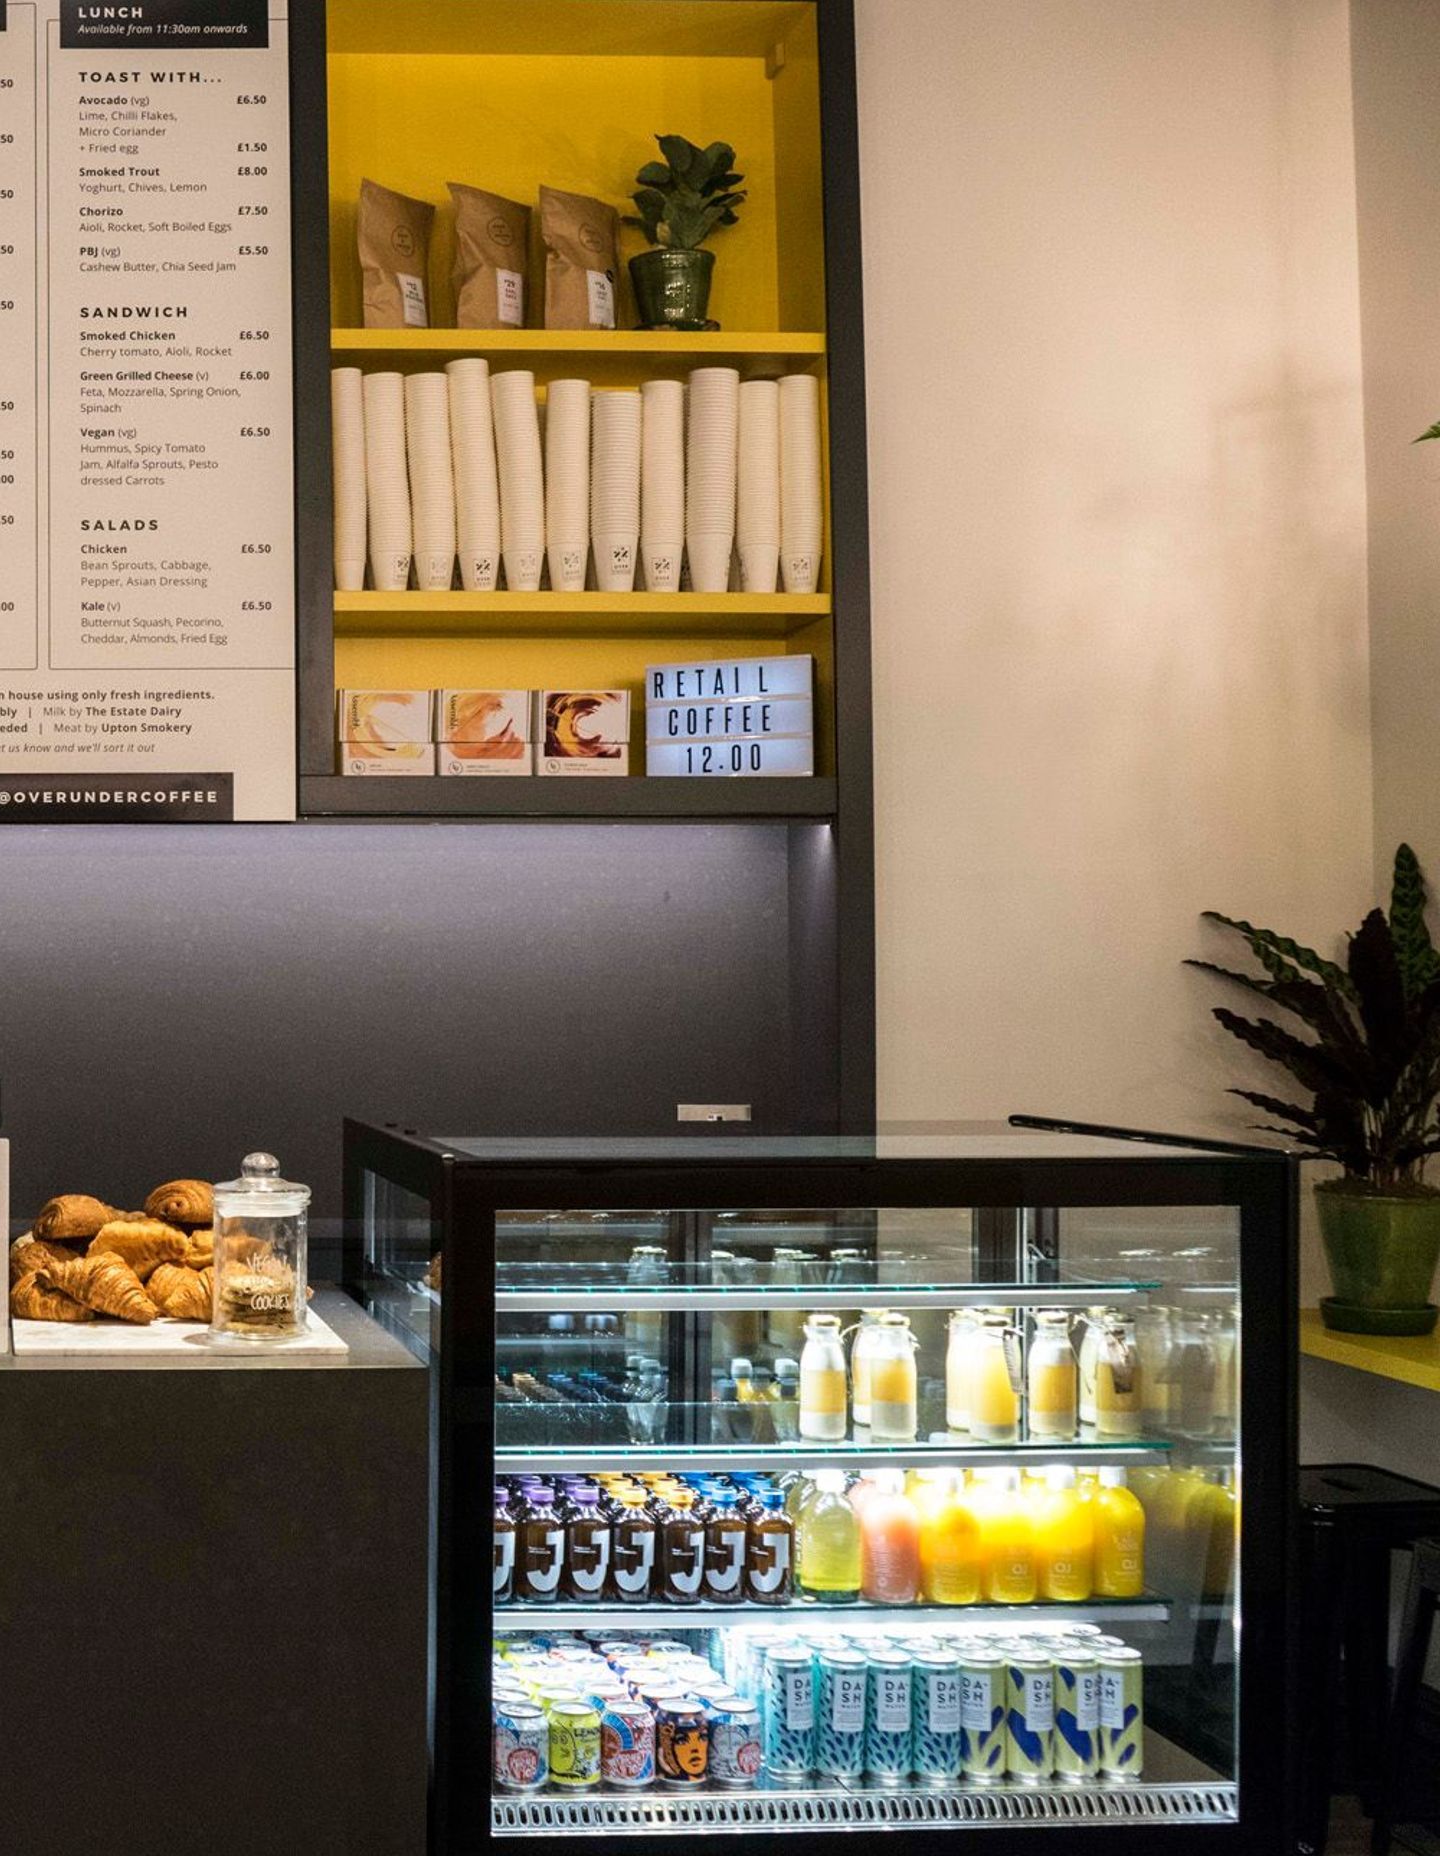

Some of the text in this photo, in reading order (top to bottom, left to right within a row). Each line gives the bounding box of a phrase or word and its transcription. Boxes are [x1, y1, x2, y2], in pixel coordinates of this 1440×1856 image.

[78, 7, 142, 18] LUNCH
[78, 23, 248, 36] Available from 11:30am onwards
[78, 71, 220, 83] TOAST WITH...
[80, 205, 268, 217] Chorizo £7.50
[80, 307, 186, 319] SANDWICH
[80, 330, 270, 341] Smoked Chicken £6.50
[80, 371, 114, 381] Green
[116, 371, 152, 381] Grilled
[154, 371, 194, 381] Cheese
[240, 371, 270, 381] £6.00
[80, 428, 116, 440] Vegan
[240, 427, 270, 438] £6.50
[80, 520, 158, 530] SALADS
[80, 543, 272, 554] Chicken £6.50
[8, 690, 44, 700] house
[48, 690, 78, 703] using
[82, 690, 108, 703] only
[110, 690, 140, 700] fresh
[144, 690, 214, 703] ingredients.
[669, 704, 772, 736] COFFEE
[24, 743, 52, 752] know
[54, 743, 74, 752] and
[104, 744, 124, 752] sort
[126, 743, 134, 752] it
[136, 744, 154, 752] out
[686, 743, 762, 773] 12.00
